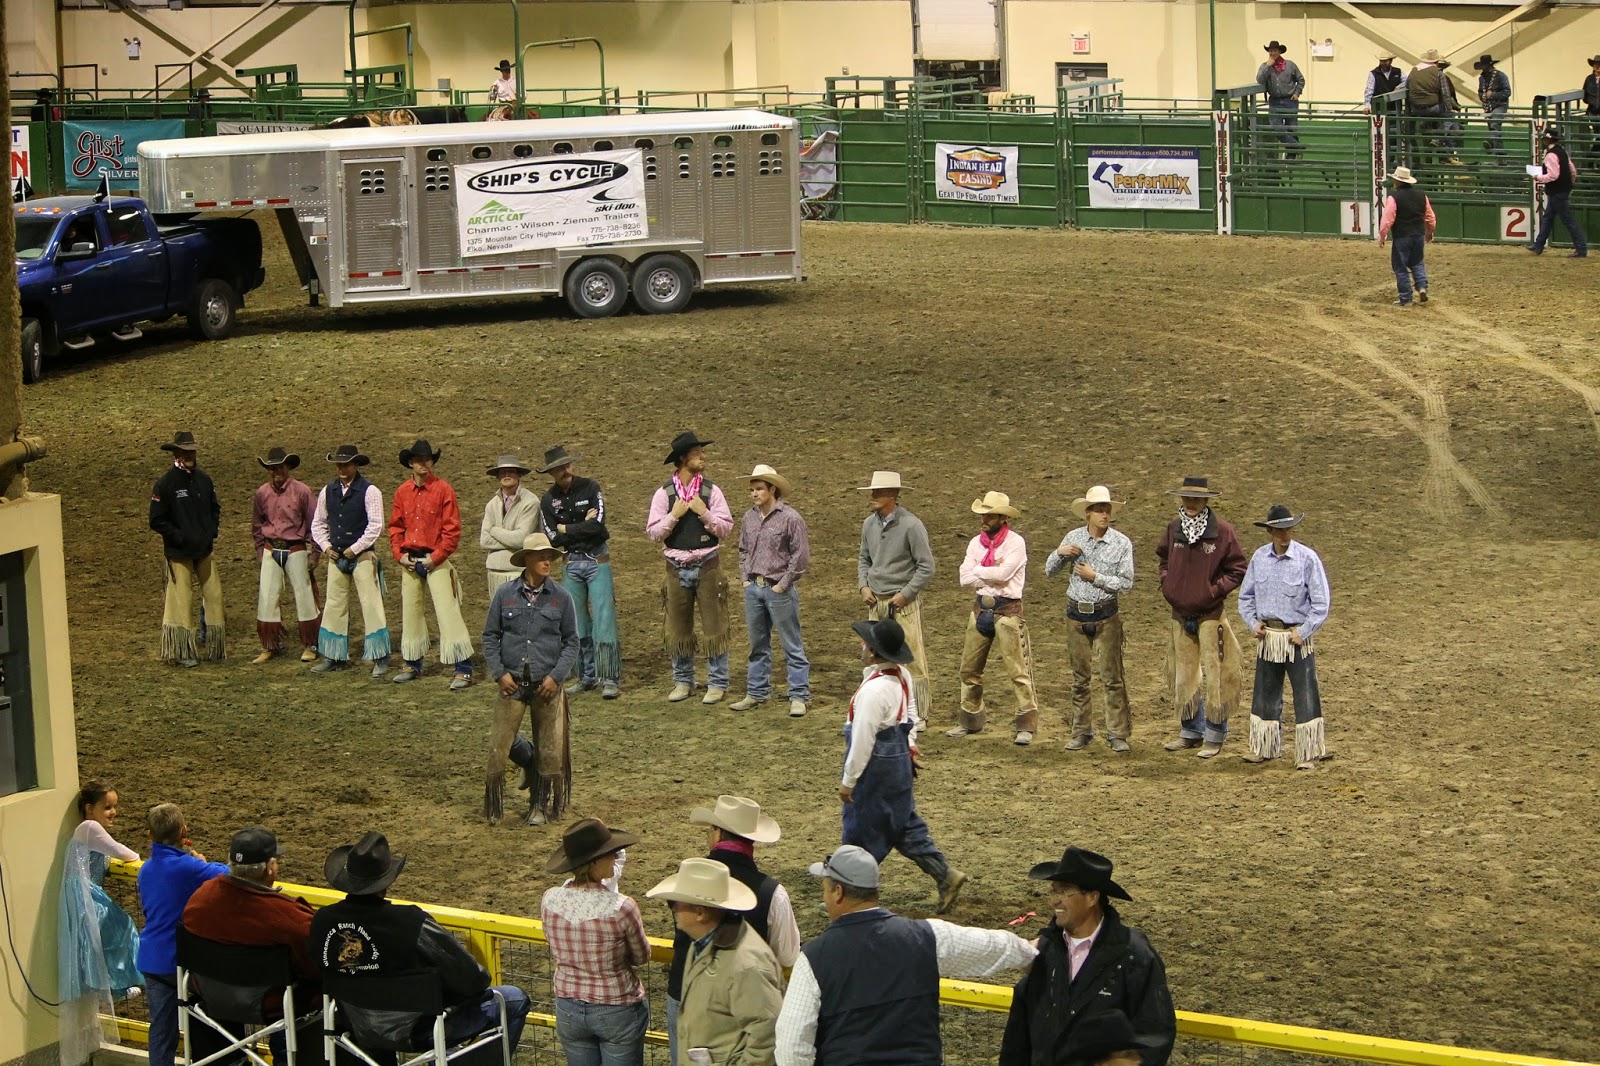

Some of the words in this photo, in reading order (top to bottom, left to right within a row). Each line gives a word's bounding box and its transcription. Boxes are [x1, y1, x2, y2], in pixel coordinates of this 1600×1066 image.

[1074, 40, 1086, 50] EXIT
[238, 125, 285, 134] QUALITY
[72, 131, 124, 177] Gist
[949, 158, 977, 171] INDIAN
[979, 162, 1002, 173] HEAD
[477, 171, 540, 188] SHIP'S
[549, 164, 614, 182] CYCLE
[959, 173, 993, 186] CASINO
[939, 190, 955, 198] GEAR
[956, 191, 965, 199] UP
[965, 192, 977, 200] FOR
[978, 193, 996, 201] GOOD
[467, 225, 512, 235] Charmac
[520, 220, 555, 229] Wilson
[562, 216, 600, 226] Zieman
[604, 211, 640, 221] Trailers
[468, 214, 505, 226] ARCTIC
[506, 212, 526, 222] CAT
[1349, 202, 1362, 233] 1
[1505, 208, 1527, 237] 2
[485, 233, 518, 244] Mountain
[519, 231, 535, 241] City
[536, 229, 566, 239] Highway
[487, 242, 513, 251] Nevada
[337, 922, 356, 930] Ranch
[357, 925, 372, 941] Hand
